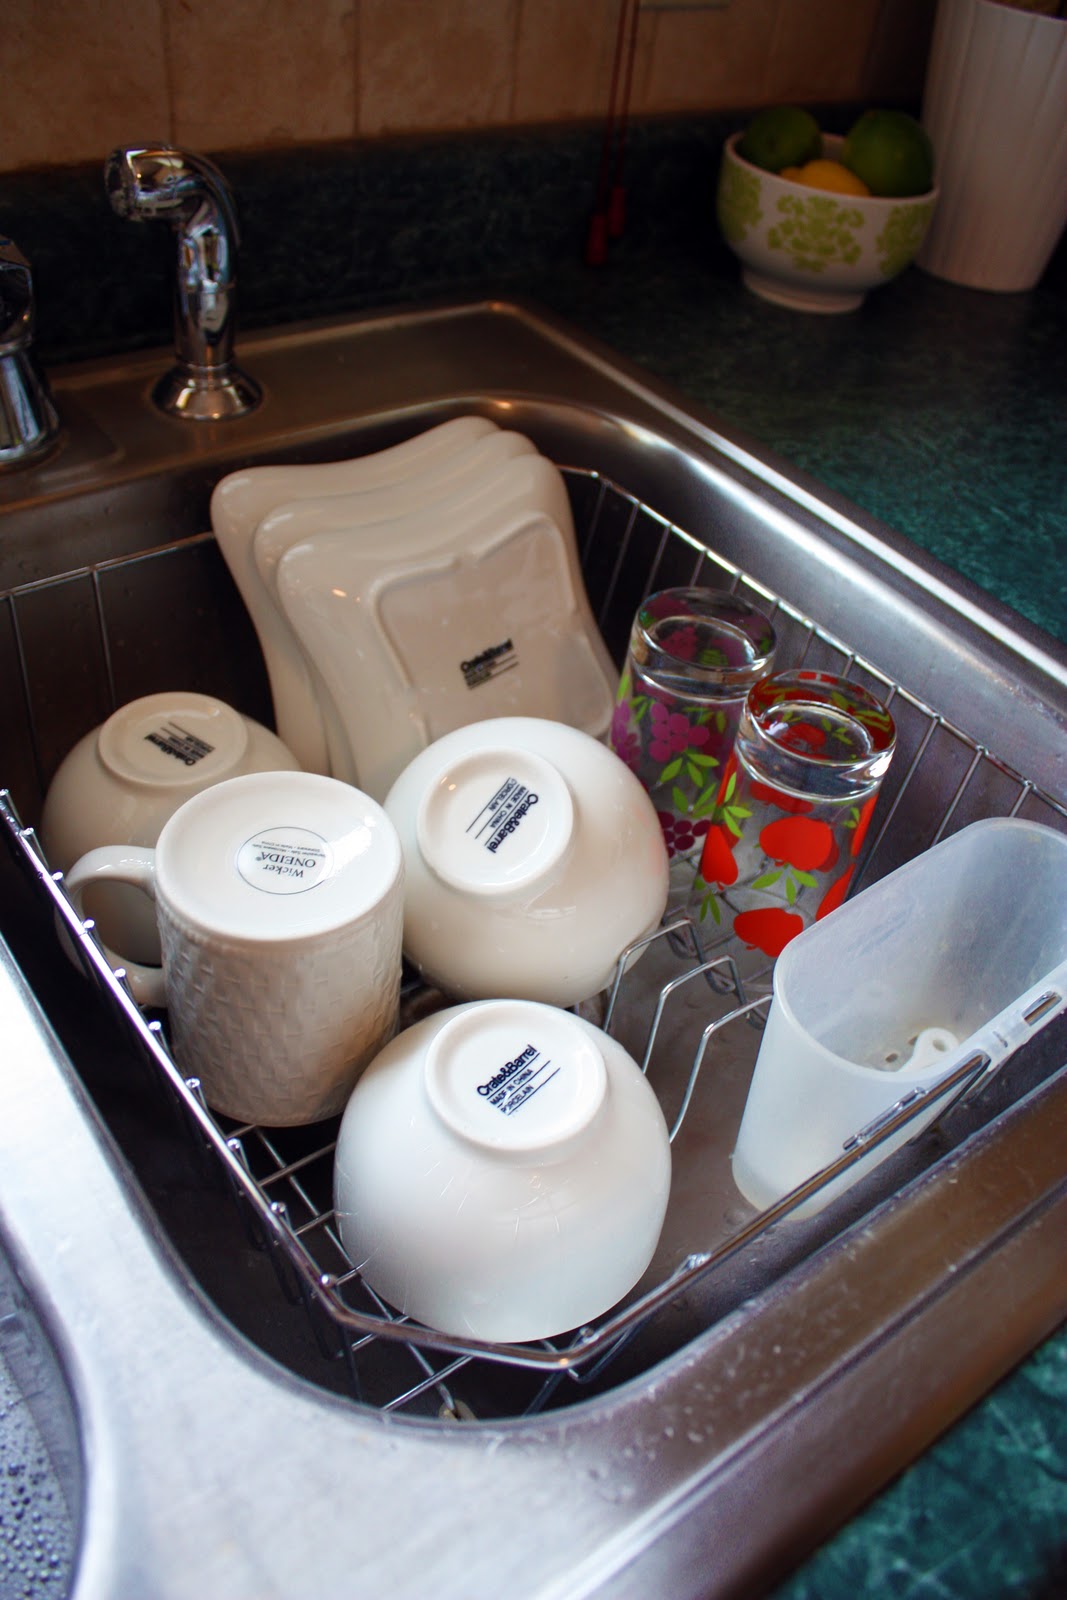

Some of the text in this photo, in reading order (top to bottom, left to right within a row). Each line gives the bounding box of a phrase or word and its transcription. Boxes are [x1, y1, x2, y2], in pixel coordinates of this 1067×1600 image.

[511, 786, 527, 803] MADE
[487, 794, 538, 853] Crate&Barrel
[490, 810, 507, 828] CHINA
[262, 864, 304, 878] Wicker
[476, 1044, 537, 1096] Crate&Barrel
[513, 1068, 534, 1085] CHINA
